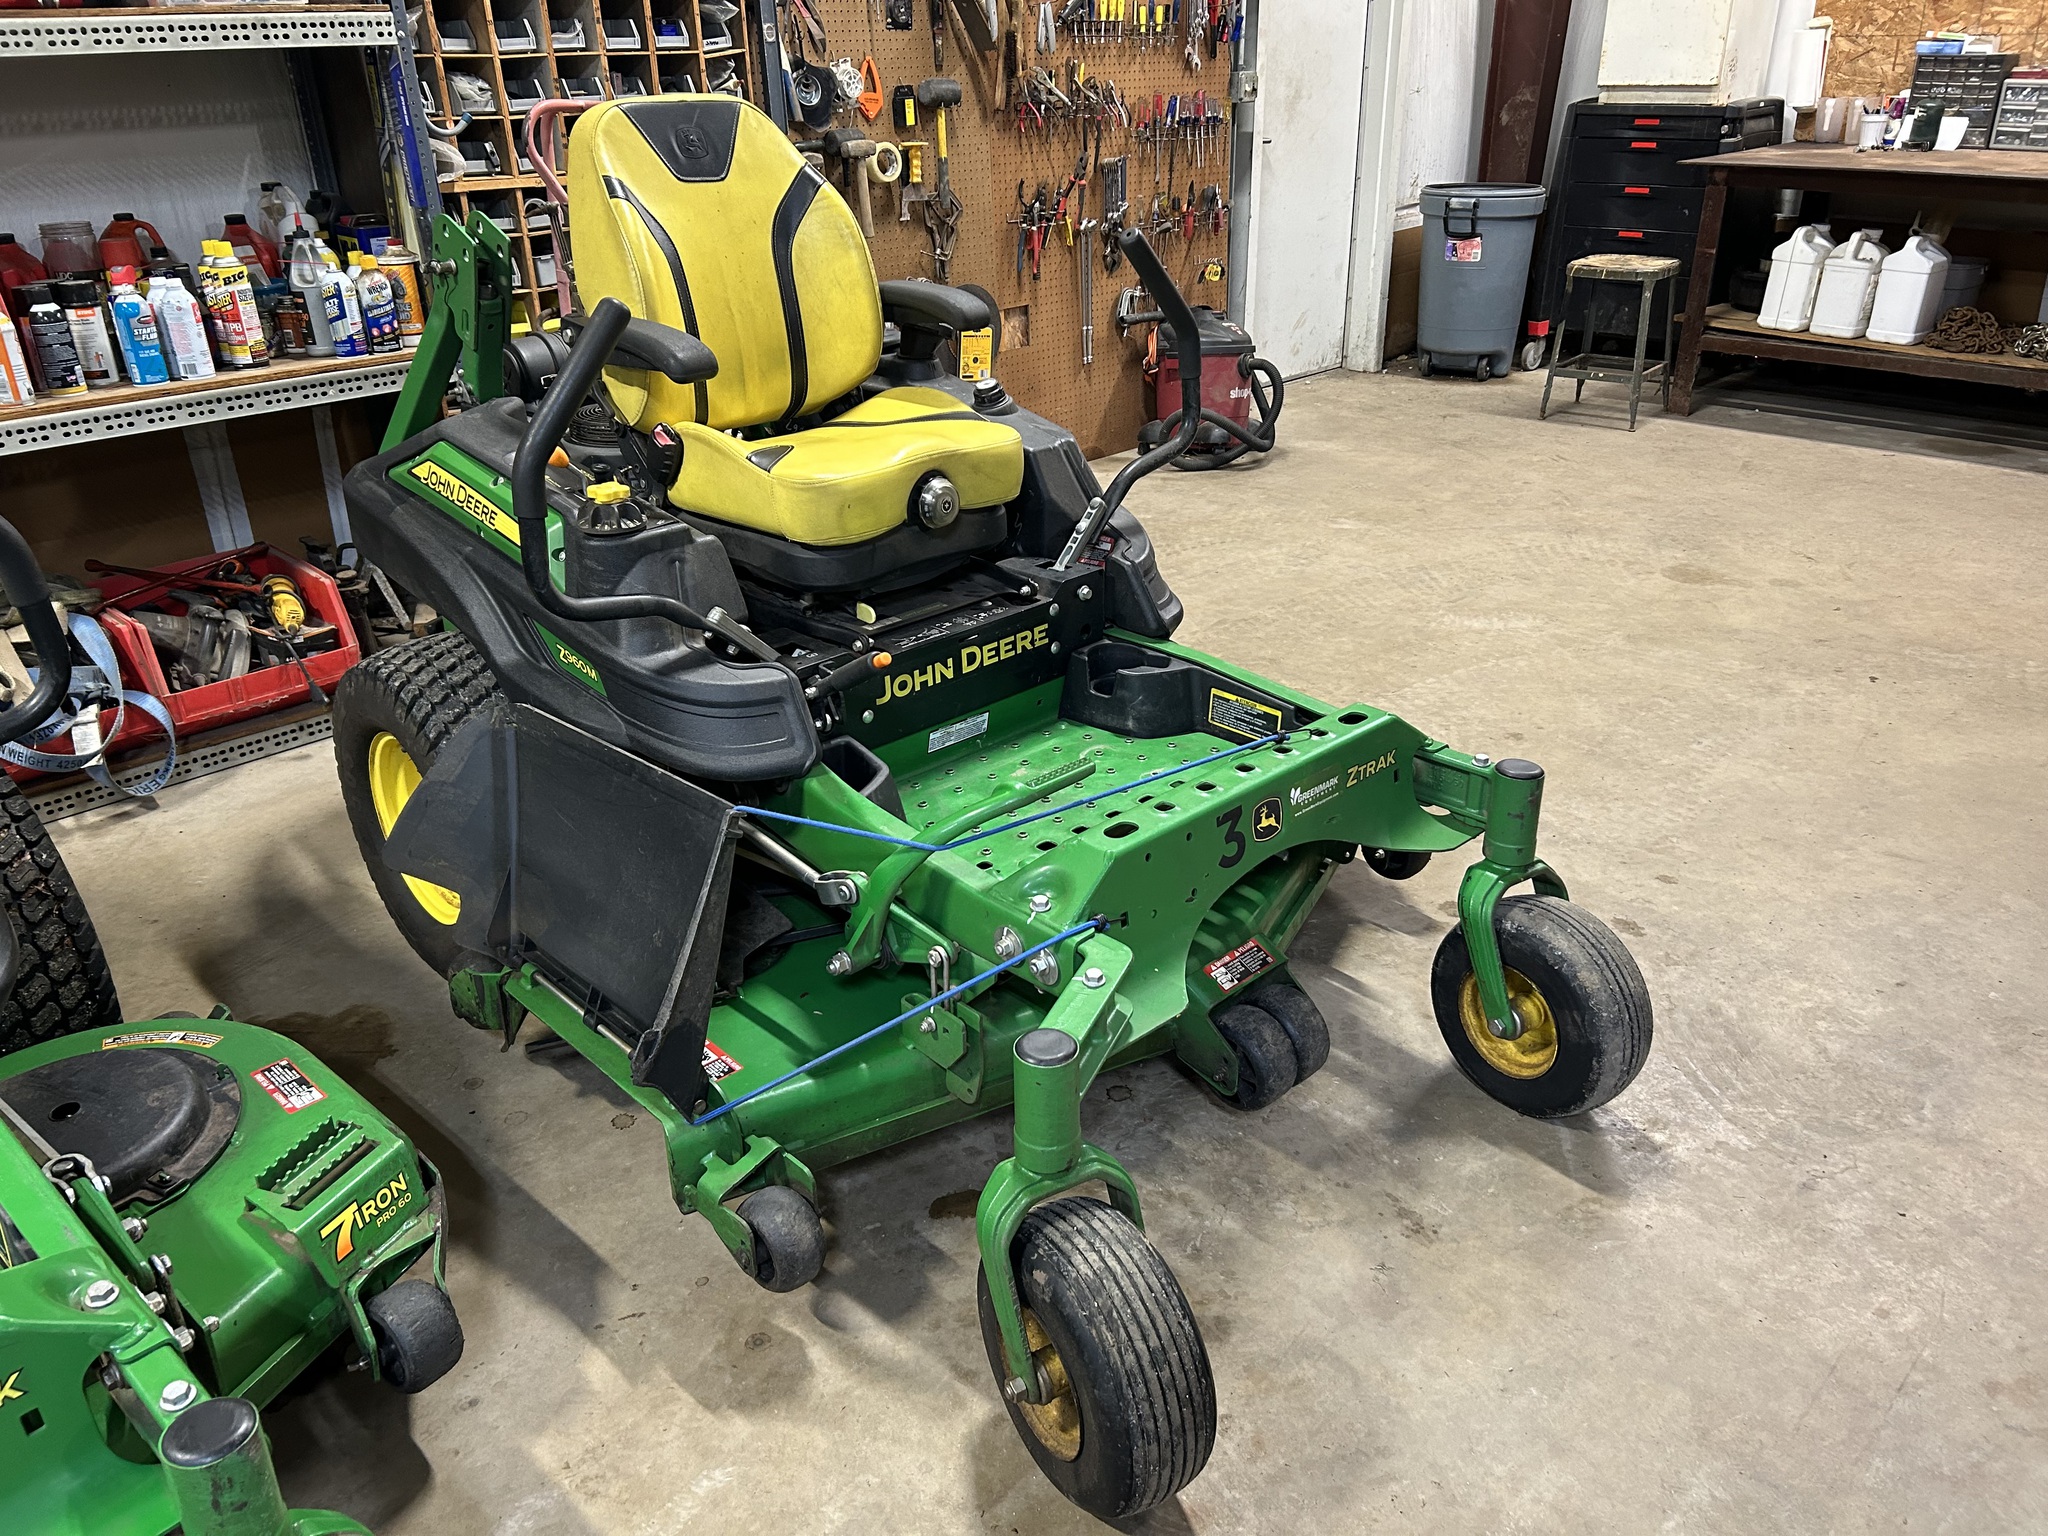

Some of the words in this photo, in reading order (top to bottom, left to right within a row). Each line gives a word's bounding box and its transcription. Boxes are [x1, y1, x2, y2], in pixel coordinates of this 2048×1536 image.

[422, 465, 456, 499] JOHN
[456, 485, 498, 527] DEERE
[556, 644, 598, 682] Z960M
[876, 658, 954, 705] JOHN
[961, 623, 1049, 674] DEERE
[8, 748, 51, 768] WEIGHT
[1346, 750, 1396, 788] ZTRAK
[1216, 805, 1246, 869] 3
[376, 1206, 397, 1227] PRO
[398, 1193, 412, 1208] 60
